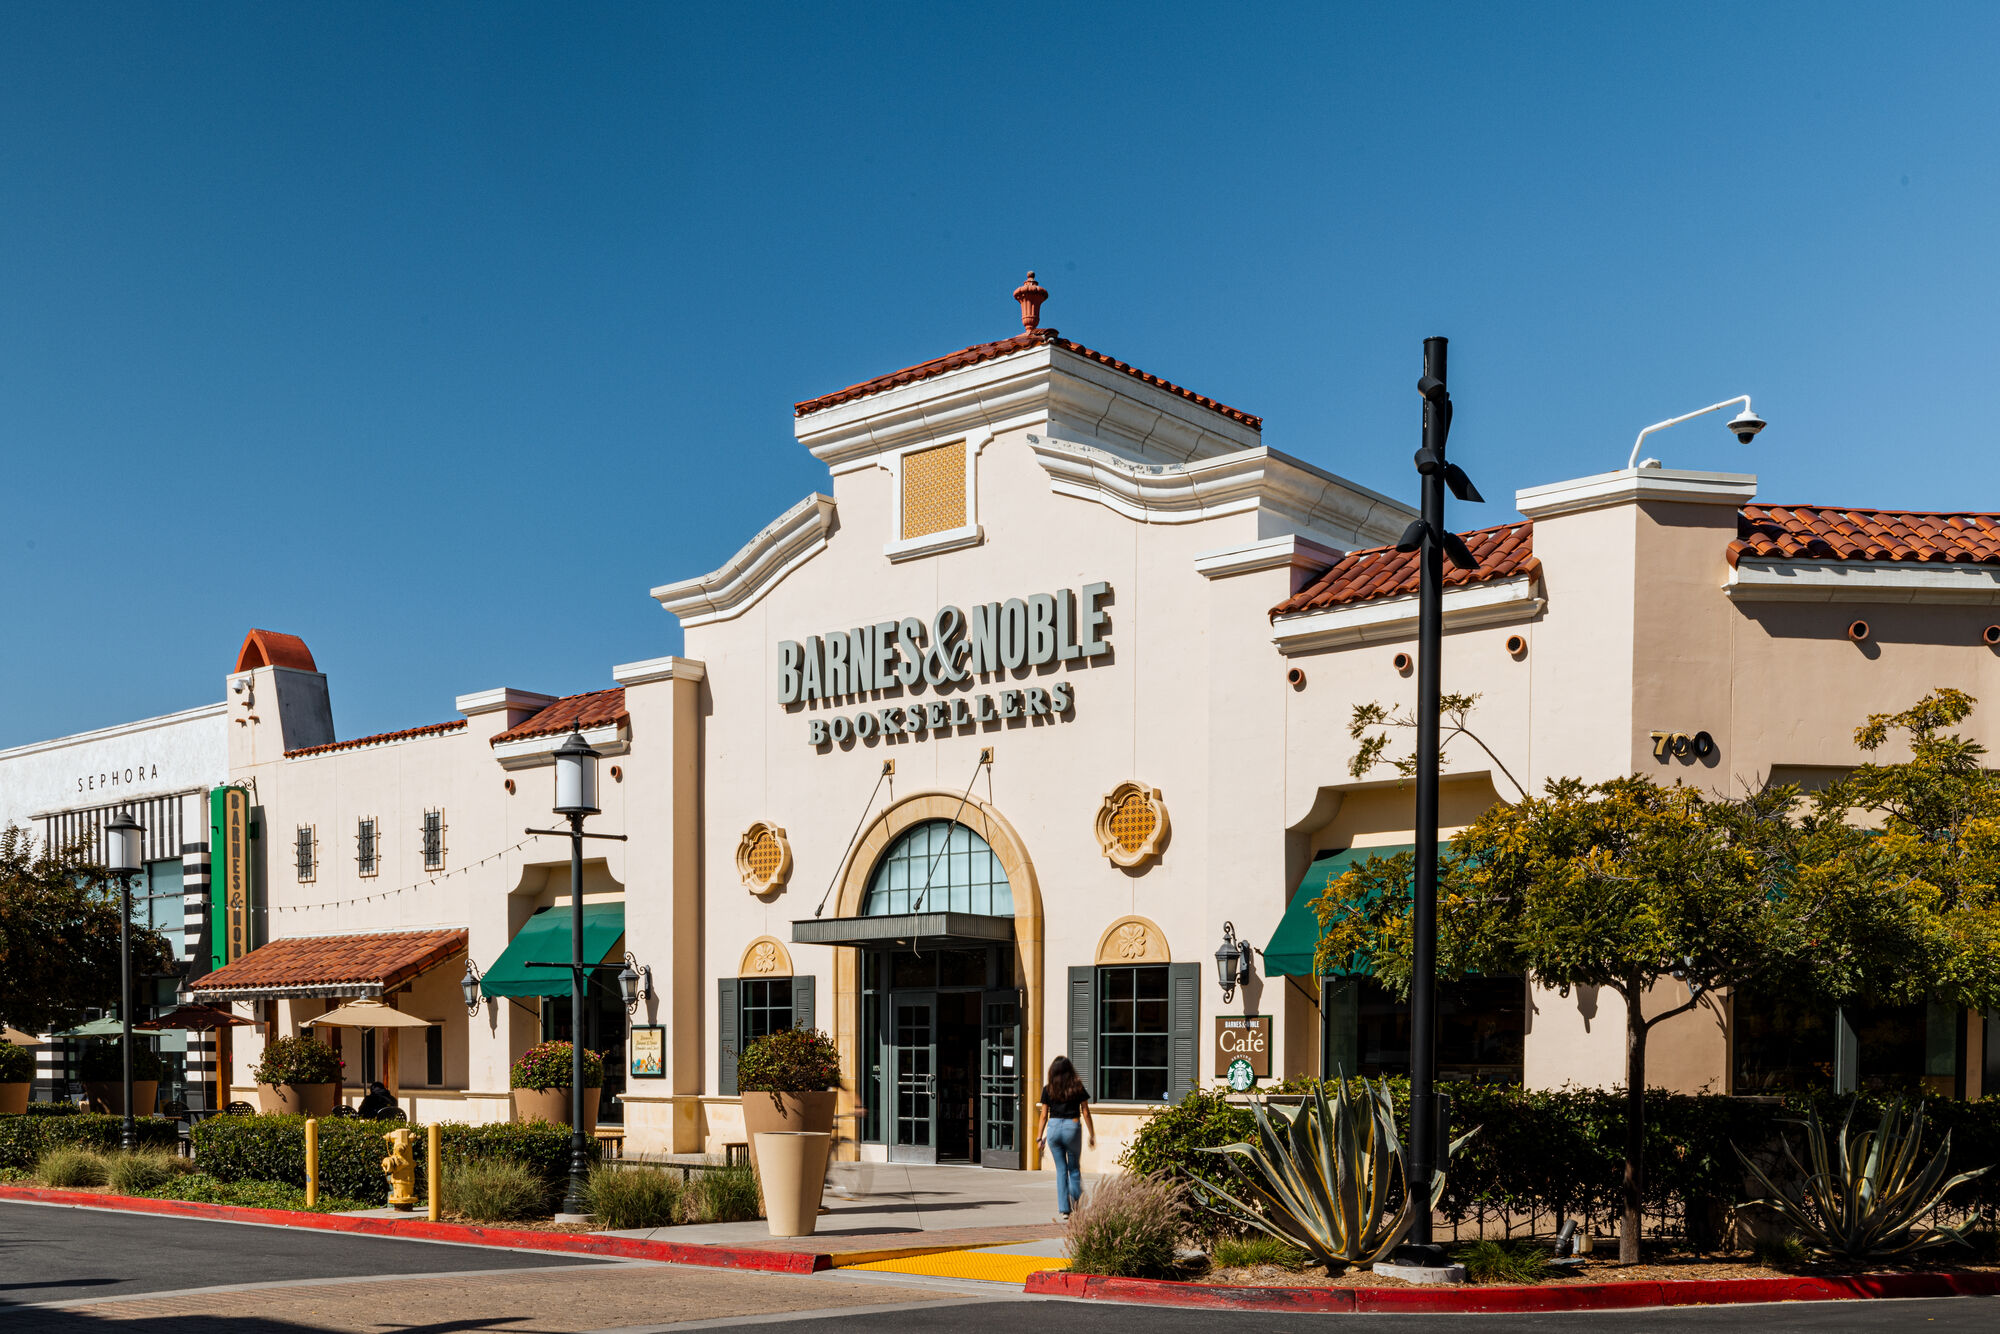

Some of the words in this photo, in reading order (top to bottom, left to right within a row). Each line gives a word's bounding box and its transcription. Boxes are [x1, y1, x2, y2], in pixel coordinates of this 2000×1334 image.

[808, 681, 1072, 746] BOOKSELLERS
[1650, 730, 1714, 757] 700
[77, 763, 158, 792] SEPHORA
[1219, 1030, 1264, 1052] Café
